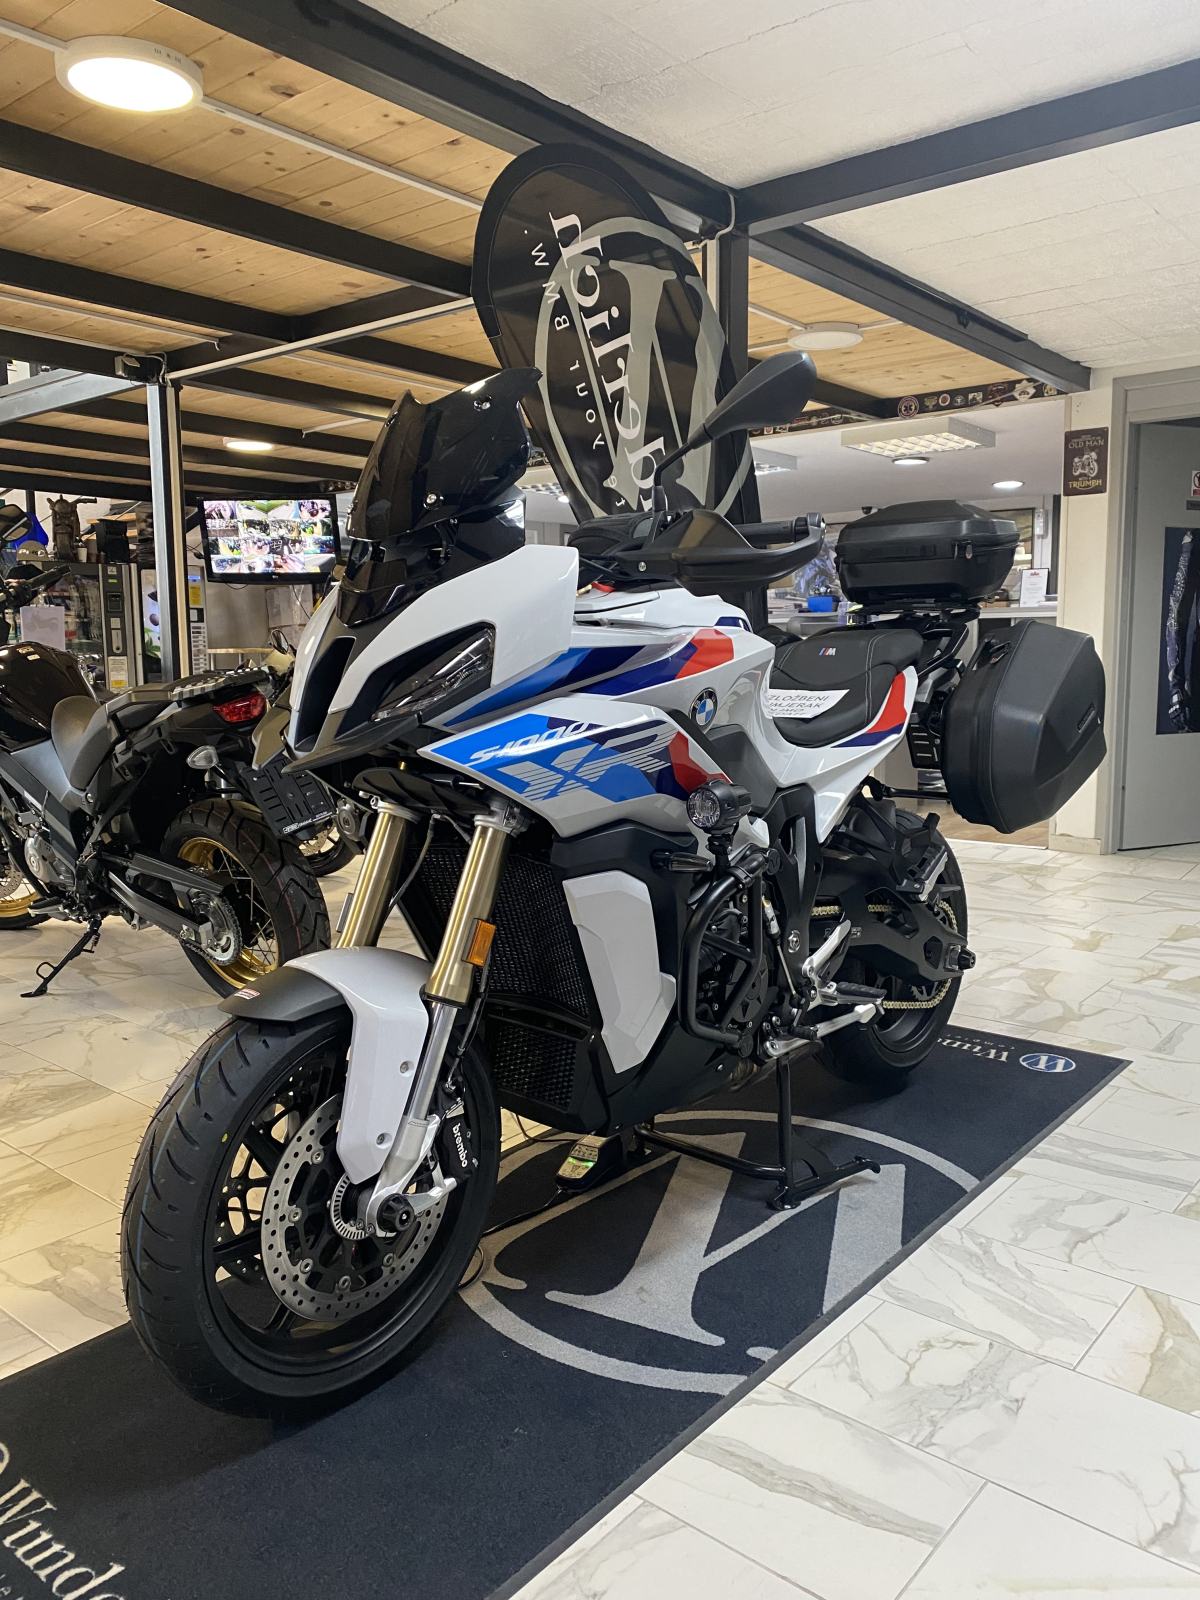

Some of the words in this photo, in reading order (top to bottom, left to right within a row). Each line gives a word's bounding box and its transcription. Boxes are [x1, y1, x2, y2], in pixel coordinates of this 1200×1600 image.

[1068, 441, 1084, 449] OLD
[1085, 439, 1105, 447] MAN
[1068, 479, 1103, 488] TRIUMPH
[768, 694, 829, 702] ZLOŽBENI
[937, 1037, 1009, 1063] Wun
[452, 1122, 468, 1168] brembo
